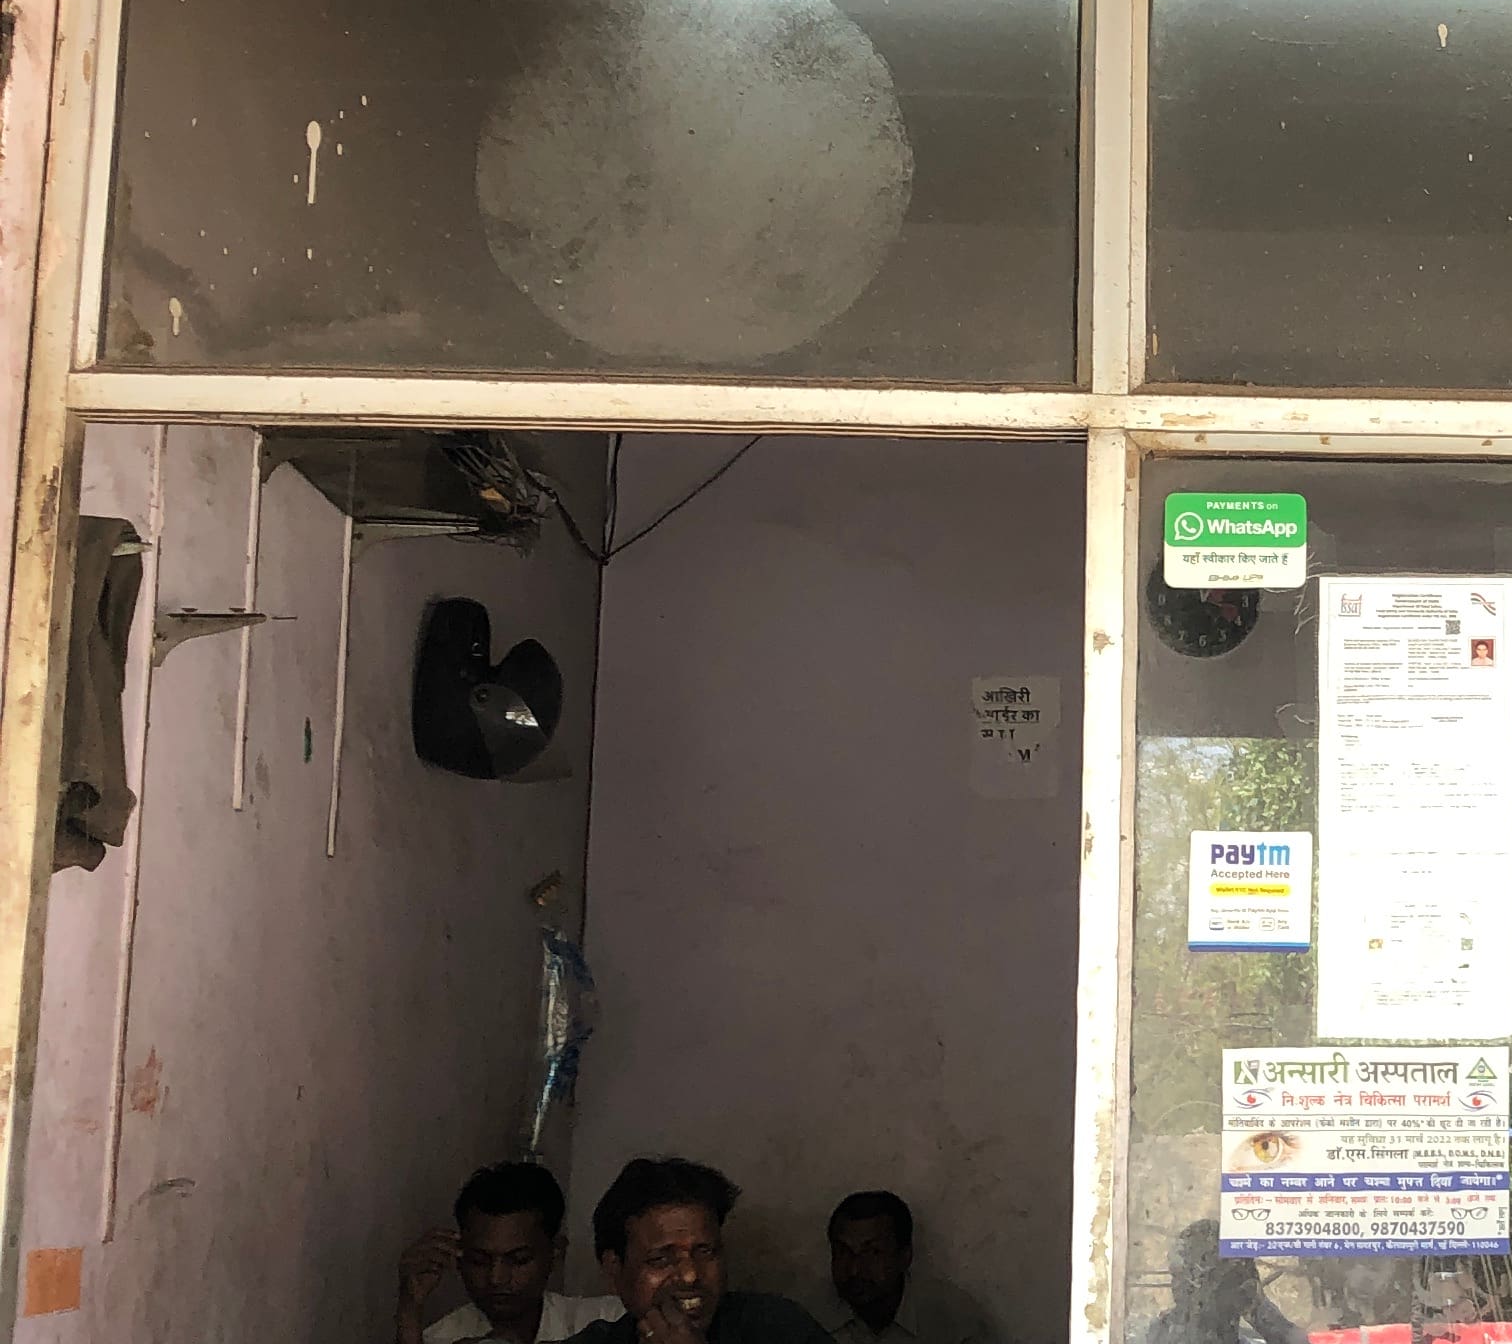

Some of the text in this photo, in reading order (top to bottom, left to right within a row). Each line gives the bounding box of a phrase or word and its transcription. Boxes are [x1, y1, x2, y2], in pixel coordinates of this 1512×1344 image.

[1207, 501, 1265, 510] PAYMENTS
[1207, 519, 1298, 538] WhatsApp
[982, 687, 1031, 703] आखिरी
[1211, 842, 1290, 865] paytm
[1211, 869, 1290, 880] Accepted Here
[1263, 1052, 1459, 1084] अन्सारी अस्पताल
[1260, 1177, 1274, 1187] का
[1343, 1177, 1358, 1187] पर
[1265, 1221, 1465, 1237] 8373904800, 9870437590
